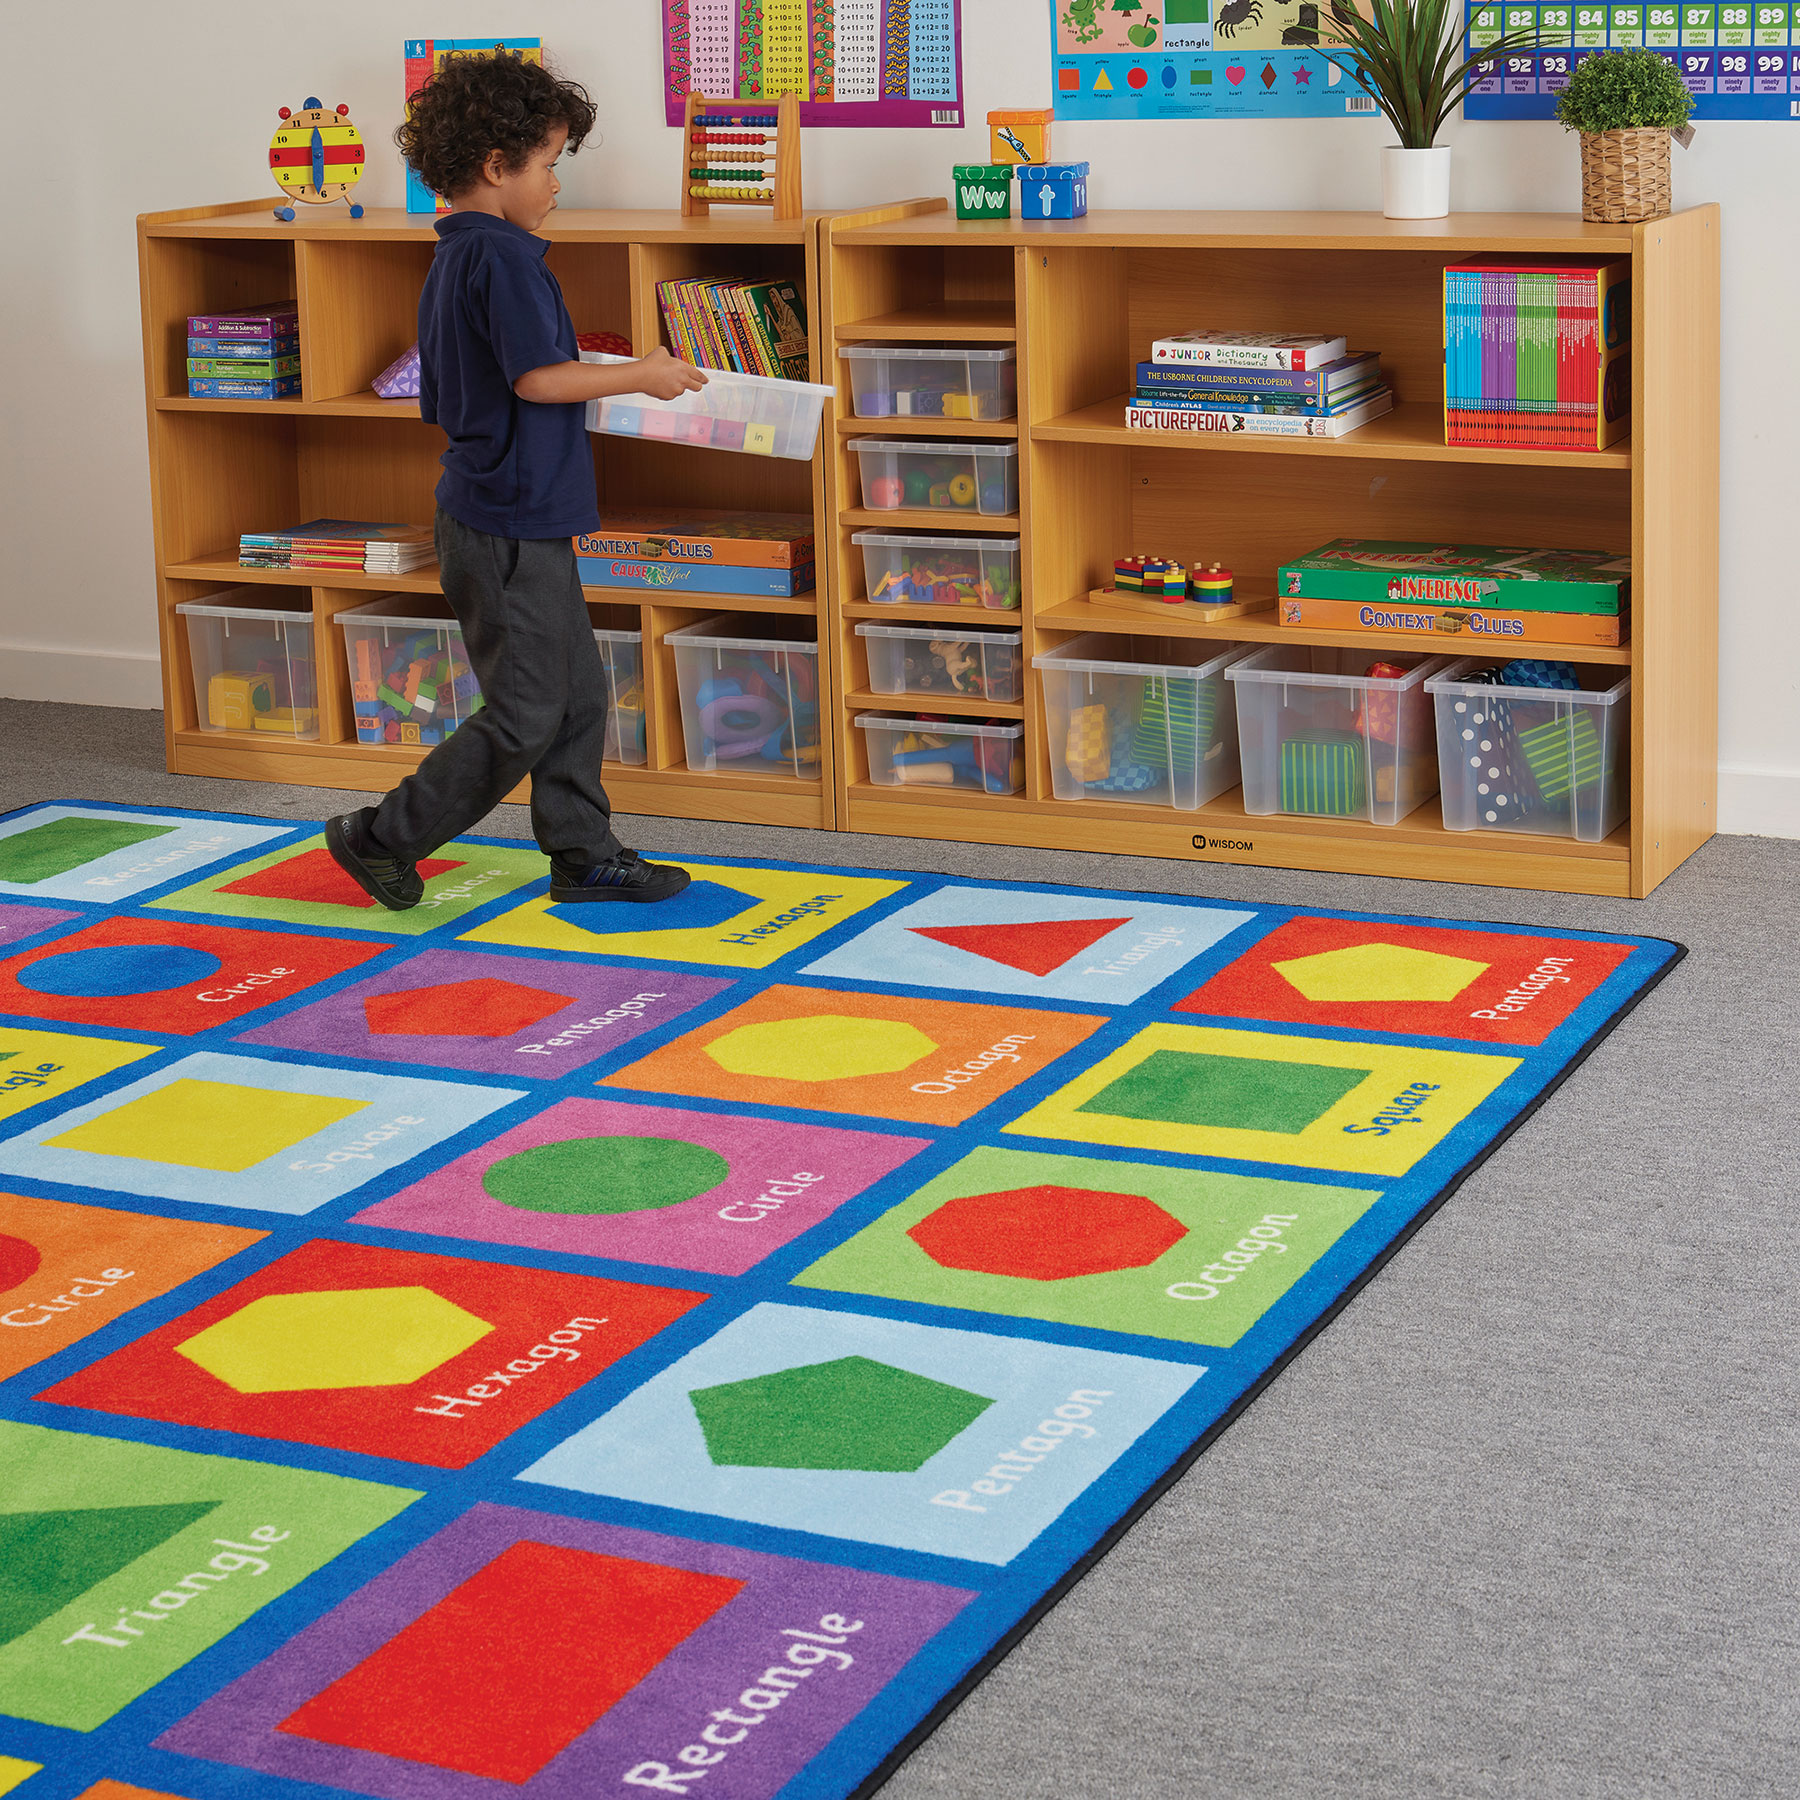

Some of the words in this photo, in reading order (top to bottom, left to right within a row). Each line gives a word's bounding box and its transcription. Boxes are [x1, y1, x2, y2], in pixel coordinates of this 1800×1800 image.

[1477, 11, 1494, 27] 81
[1509, 11, 1533, 26] 82
[1544, 11, 1568, 26] 83
[1579, 11, 1603, 26] 84
[1615, 10, 1638, 26] 85
[1650, 9, 1675, 25] 86
[1687, 9, 1711, 25] 87
[1722, 9, 1747, 25] 88
[1759, 8, 1784, 24] 89
[1688, 31, 1707, 39] eighty
[1165, 38, 1210, 49] rectangle
[1477, 58, 1494, 73] 91
[1508, 58, 1532, 73] 92
[1543, 57, 1567, 73] 93
[1686, 57, 1710, 72] 97
[1721, 56, 1746, 72] 98
[1757, 56, 1784, 72] 99
[1724, 78, 1743, 86] ninety
[1761, 78, 1780, 86] ninety
[348, 129, 355, 137] 2
[283, 173, 289, 181] 8
[352, 167, 357, 175] 4
[300, 186, 305, 194] 7
[321, 190, 327, 198] 6
[340, 183, 346, 191] 5
[960, 185, 1007, 210] Ww
[1039, 184, 1056, 217] t
[1170, 349, 1211, 360] JUNIOR
[1217, 349, 1268, 360] Dictionary
[1229, 358, 1267, 367] Thesaurus
[1147, 372, 1161, 380] THE
[1163, 373, 1195, 382] USBORNE
[1197, 375, 1238, 384] CHILDREN'S
[1239, 376, 1293, 387] ENCYCLOPEDIA
[1188, 389, 1215, 401] General
[1215, 391, 1248, 404] Knowledge
[1130, 410, 1230, 432] PICTUREPEDIA
[1256, 418, 1303, 427] encyclopedia
[754, 432, 763, 442] in
[578, 534, 640, 555] CONTEXT
[668, 538, 713, 559] CLUES
[610, 561, 648, 578] CAUSE
[1402, 576, 1481, 603] INFERENCE
[1359, 606, 1435, 631] CONTEXT
[1469, 612, 1524, 636] CLUES
[1209, 839, 1253, 851] WISDOM
[84, 835, 233, 886] Rectangle
[720, 892, 843, 946] Hexagon
[1082, 925, 1188, 977] Triangle
[197, 967, 295, 1005] Circle
[1469, 957, 1574, 1021] Pentagon
[514, 991, 667, 1056] Pentagon
[911, 1033, 1036, 1095] Octagon
[1342, 1081, 1441, 1137] Square
[288, 1114, 426, 1173] Square
[718, 1171, 824, 1223] Circle
[1166, 1212, 1298, 1302] Octagon
[0, 1266, 135, 1329] Circle
[413, 1315, 608, 1420] Hexagon
[929, 1388, 1115, 1515] Pentagon
[62, 1523, 291, 1650] Triangle
[622, 1613, 864, 1794] Rectangle
